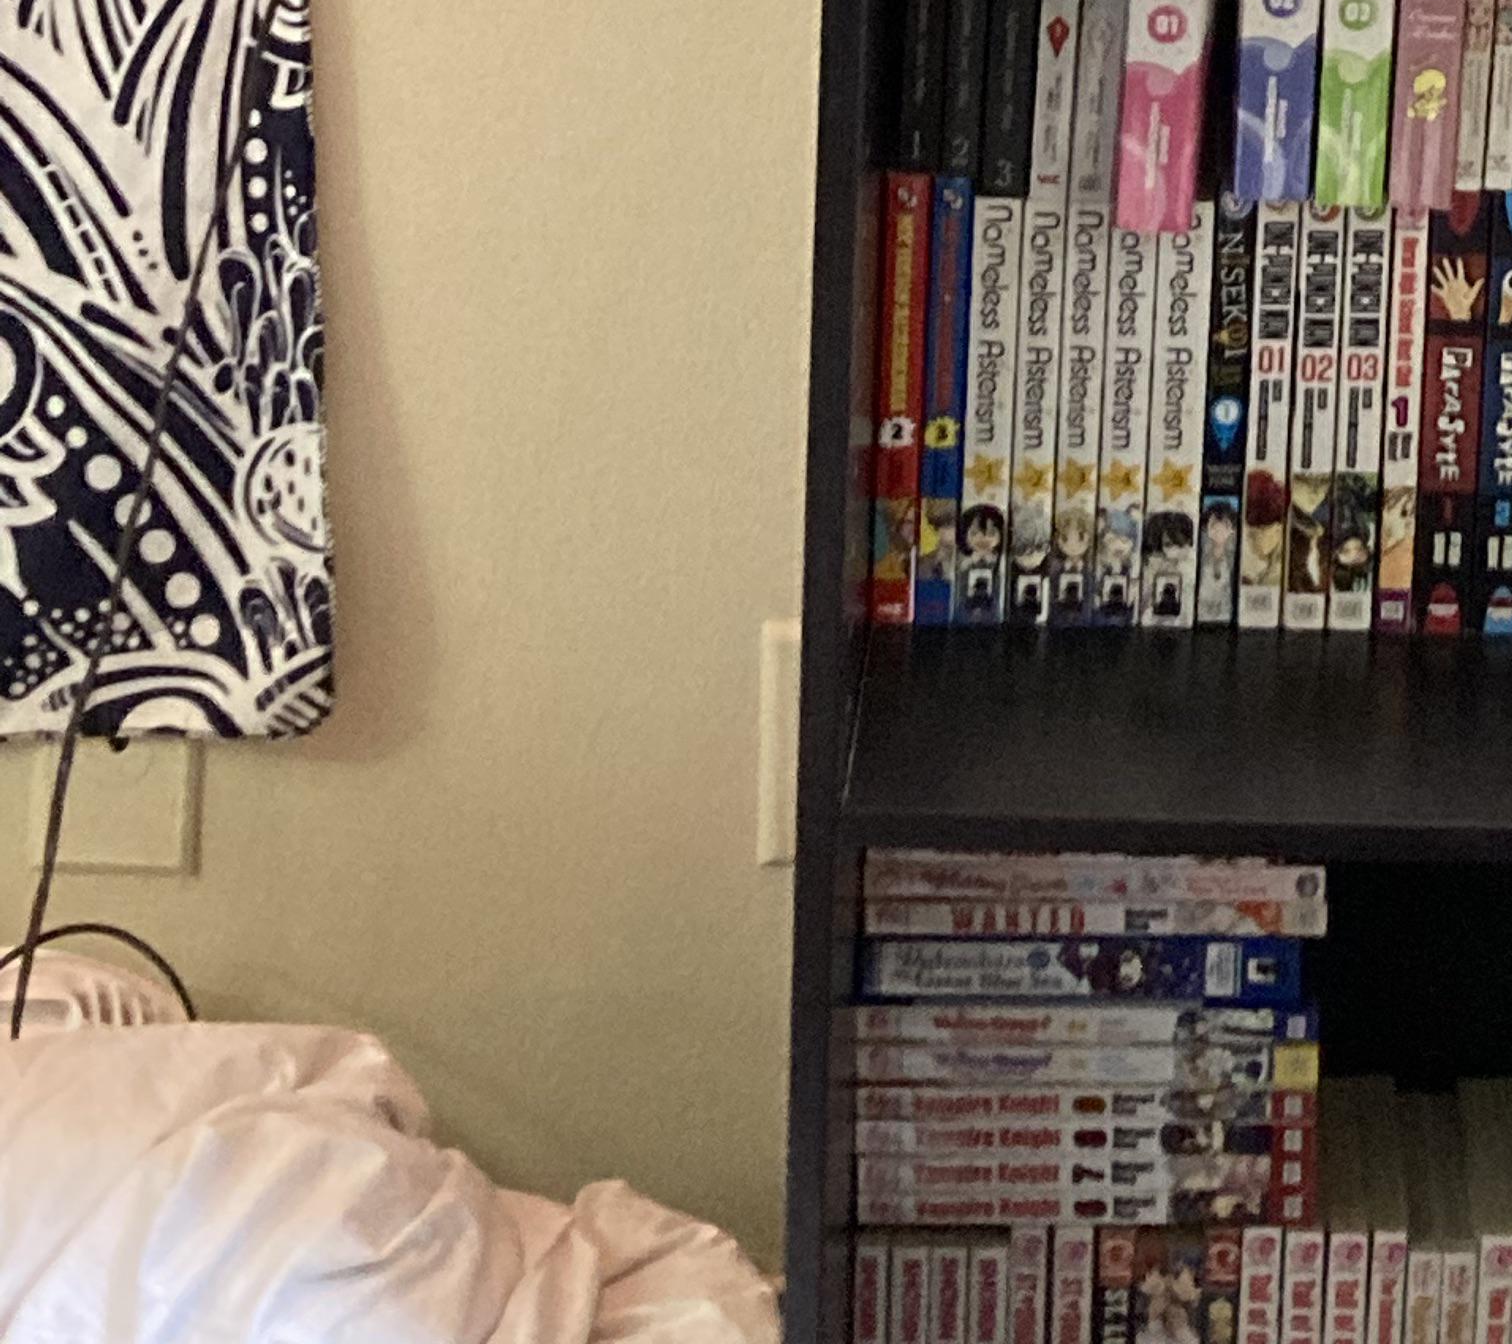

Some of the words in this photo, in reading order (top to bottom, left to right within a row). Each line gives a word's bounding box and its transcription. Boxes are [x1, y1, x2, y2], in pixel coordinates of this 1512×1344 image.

[981, 204, 1012, 342] Nameless
[1028, 213, 1059, 337] Nameless
[1072, 209, 1101, 335] Nameless
[975, 340, 1005, 444] Asterism
[1023, 344, 1050, 450] Asterism
[1067, 344, 1095, 449] Asterism
[1112, 344, 1141, 451] Asterism
[1164, 346, 1194, 451] Asterism
[1259, 346, 1286, 373] 01
[1302, 354, 1333, 380] 02
[1347, 354, 1379, 380] 03
